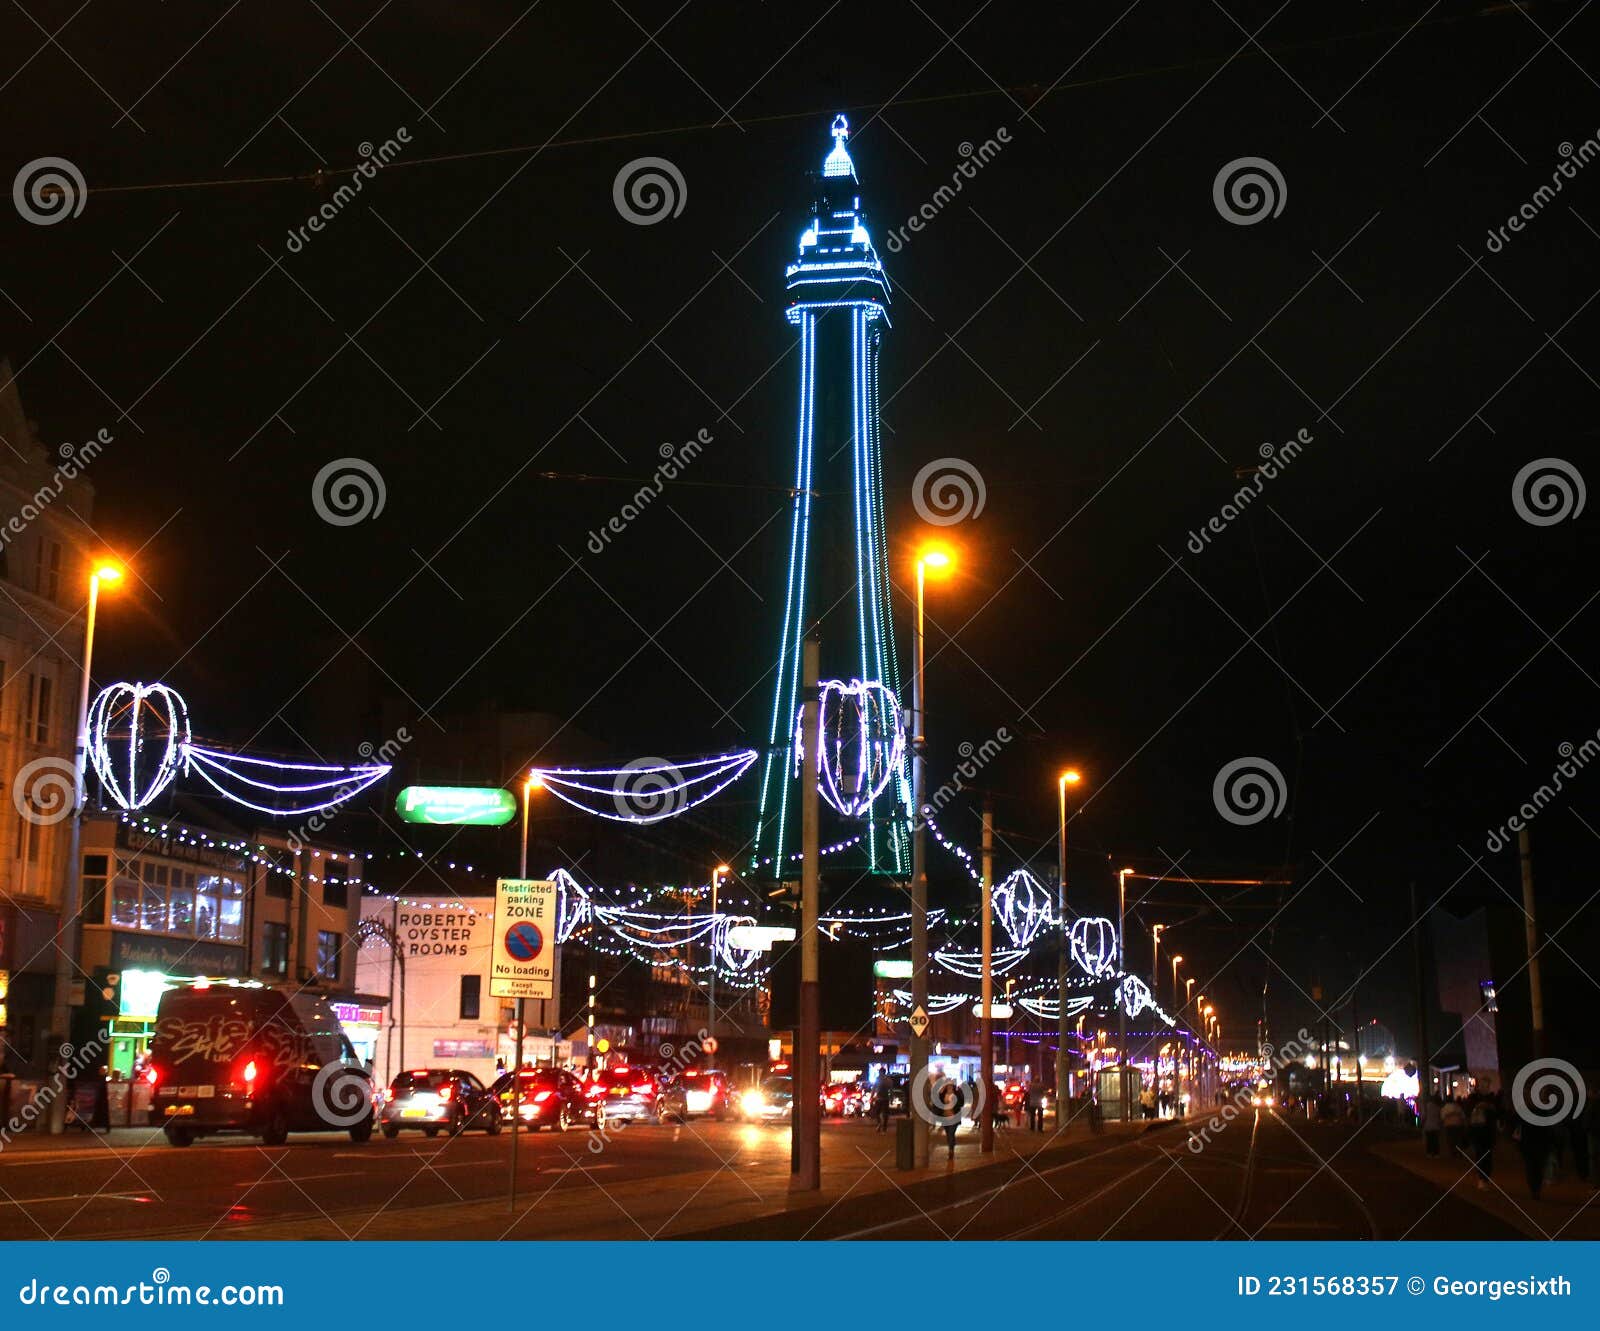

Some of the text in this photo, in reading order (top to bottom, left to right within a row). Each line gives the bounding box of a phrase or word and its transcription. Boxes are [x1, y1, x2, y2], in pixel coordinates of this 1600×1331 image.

[501, 883, 552, 893] Restricted
[507, 895, 544, 906] parking
[507, 907, 544, 918] ZONE
[407, 929, 471, 941] OYSTER
[410, 943, 468, 956] ROOMS
[496, 964, 550, 977] No loading
[911, 1016, 927, 1025] 30
[213, 1054, 233, 1063] UK
